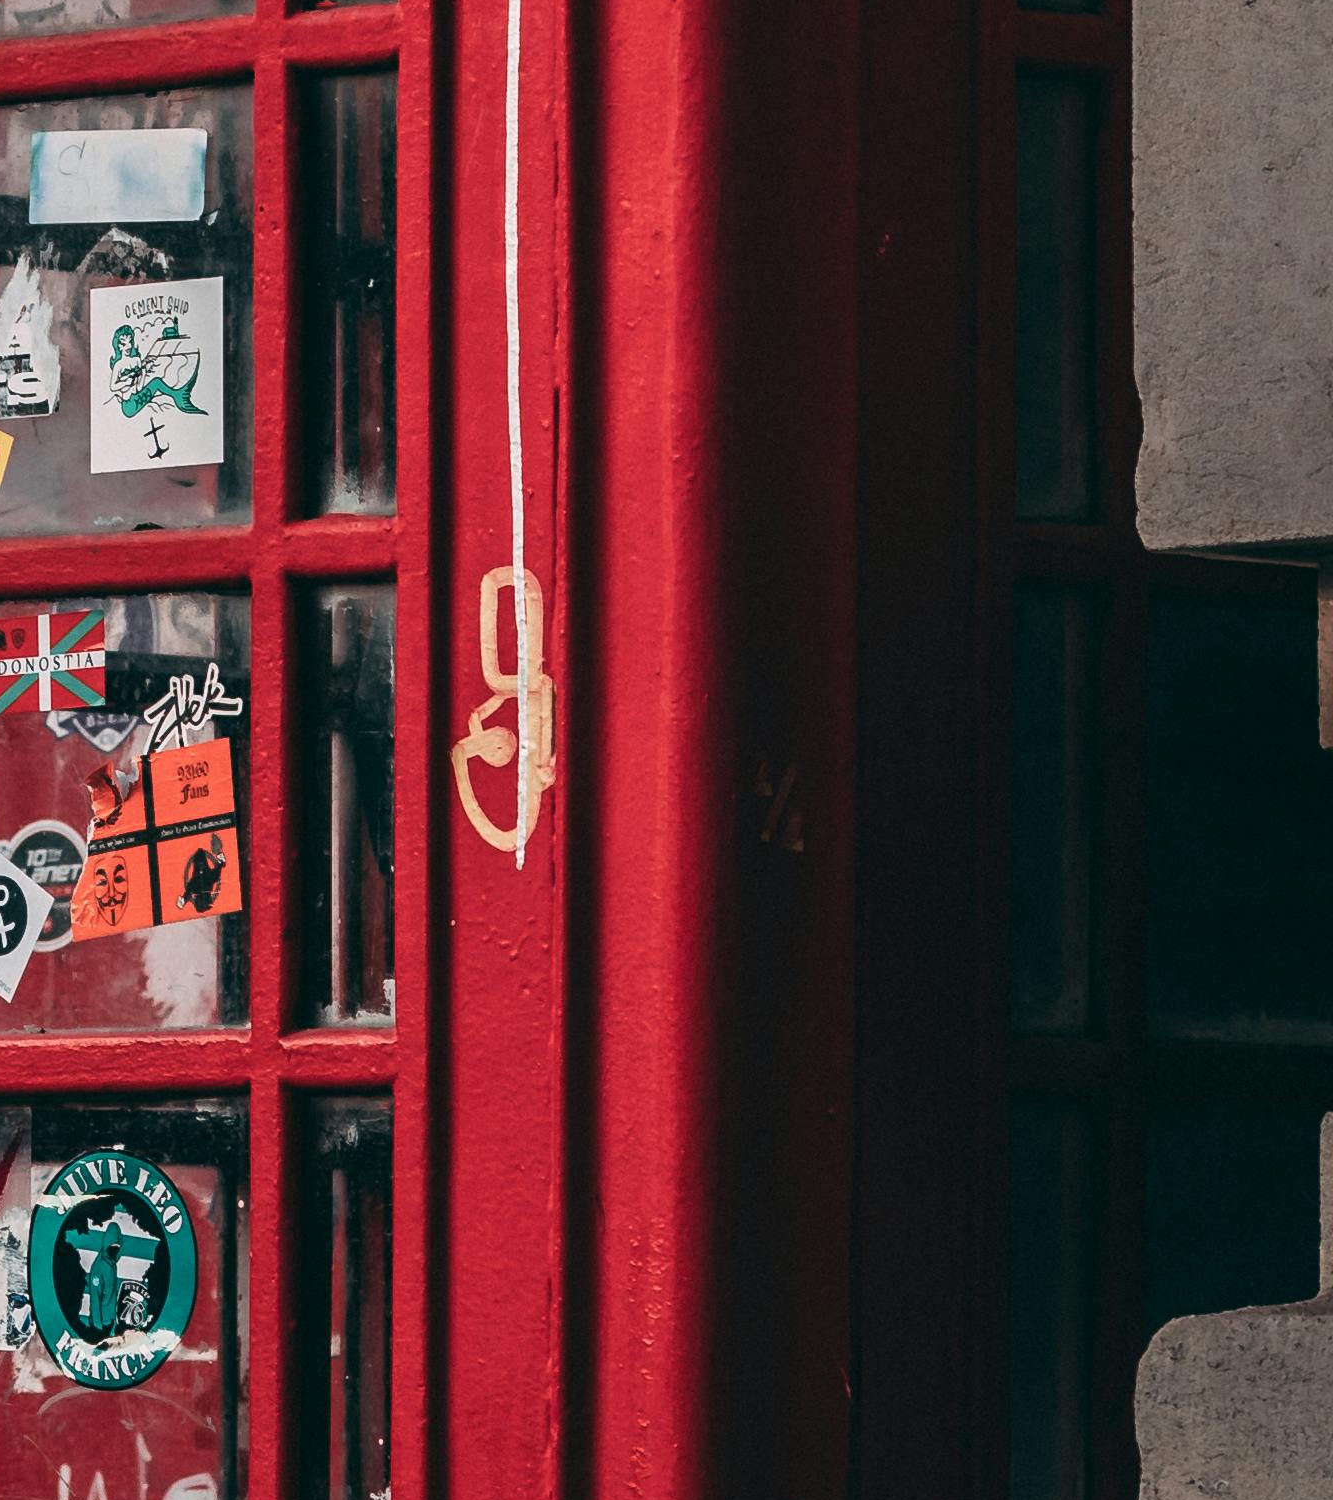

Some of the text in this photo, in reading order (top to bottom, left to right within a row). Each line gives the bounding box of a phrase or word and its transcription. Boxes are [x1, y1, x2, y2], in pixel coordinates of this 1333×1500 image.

[124, 296, 164, 319] CEMENT
[167, 296, 190, 316] SHIP
[55, 1158, 183, 1234] JUVE LEO
